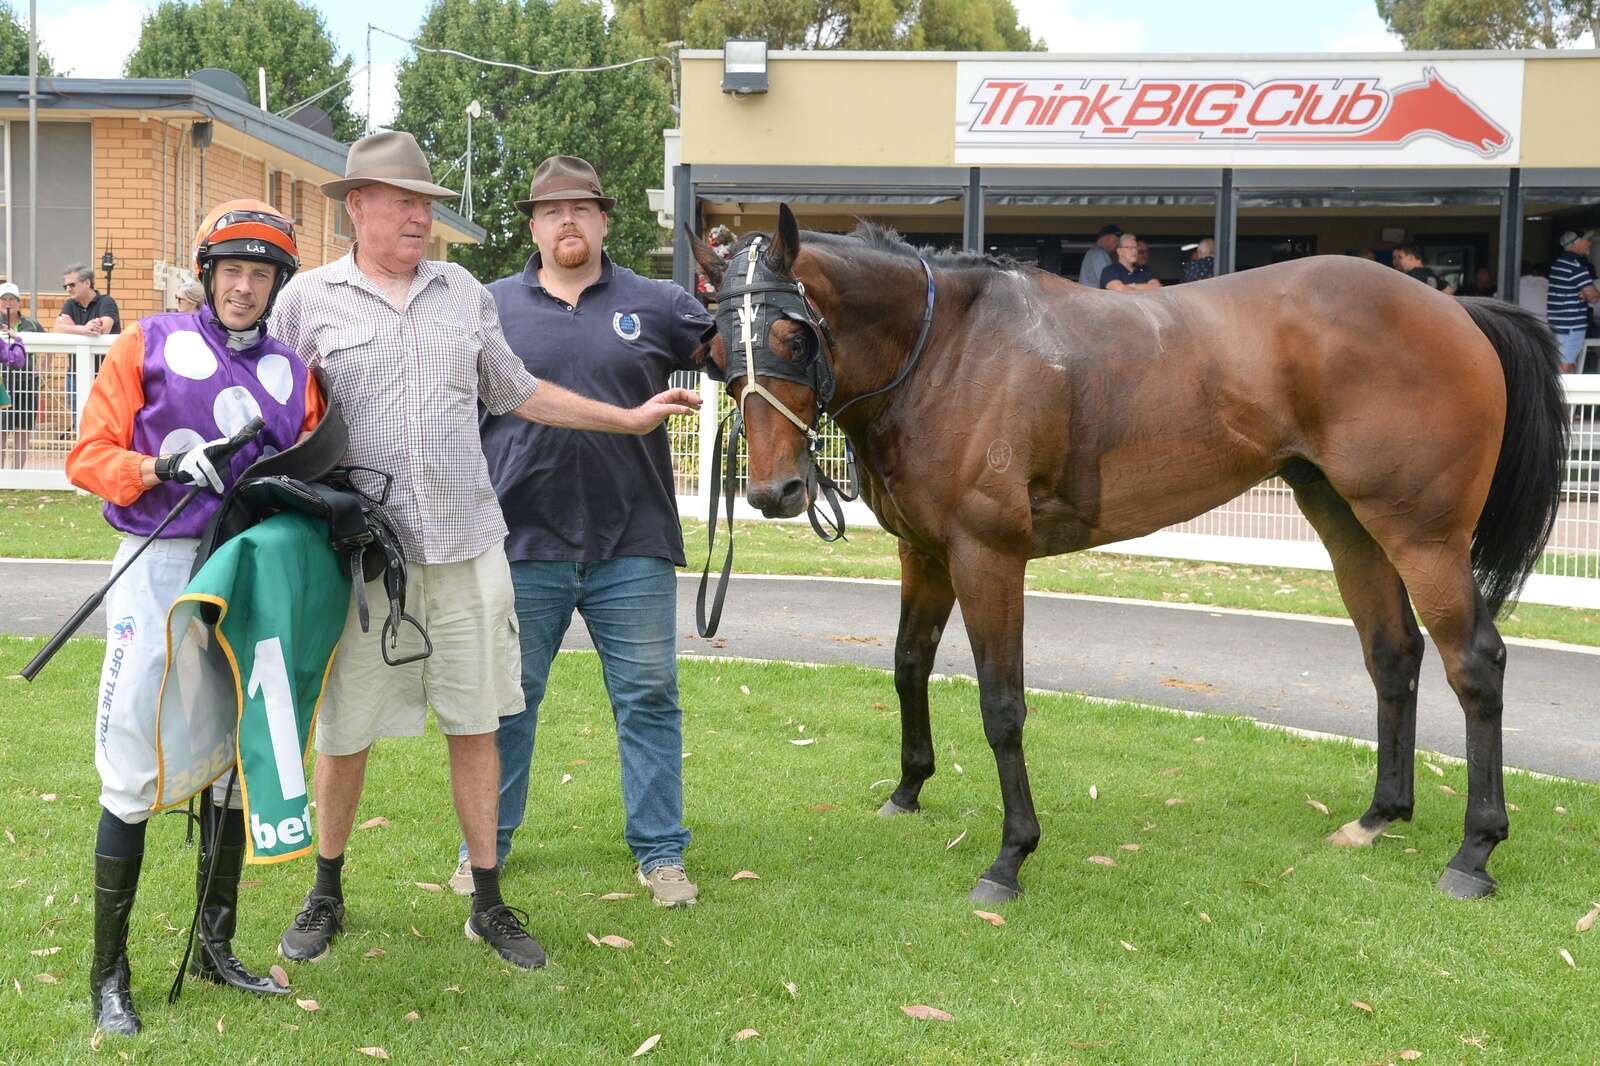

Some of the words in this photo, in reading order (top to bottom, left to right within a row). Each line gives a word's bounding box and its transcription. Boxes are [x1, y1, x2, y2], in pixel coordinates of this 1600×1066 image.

[981, 82, 1124, 126] Think
[1121, 84, 1246, 127] BIG
[1246, 83, 1384, 127] Club
[246, 244, 266, 254] LAS
[109, 647, 124, 679] OFF
[102, 681, 116, 712] THE
[100, 714, 110, 746] TRA
[247, 636, 307, 801] 1
